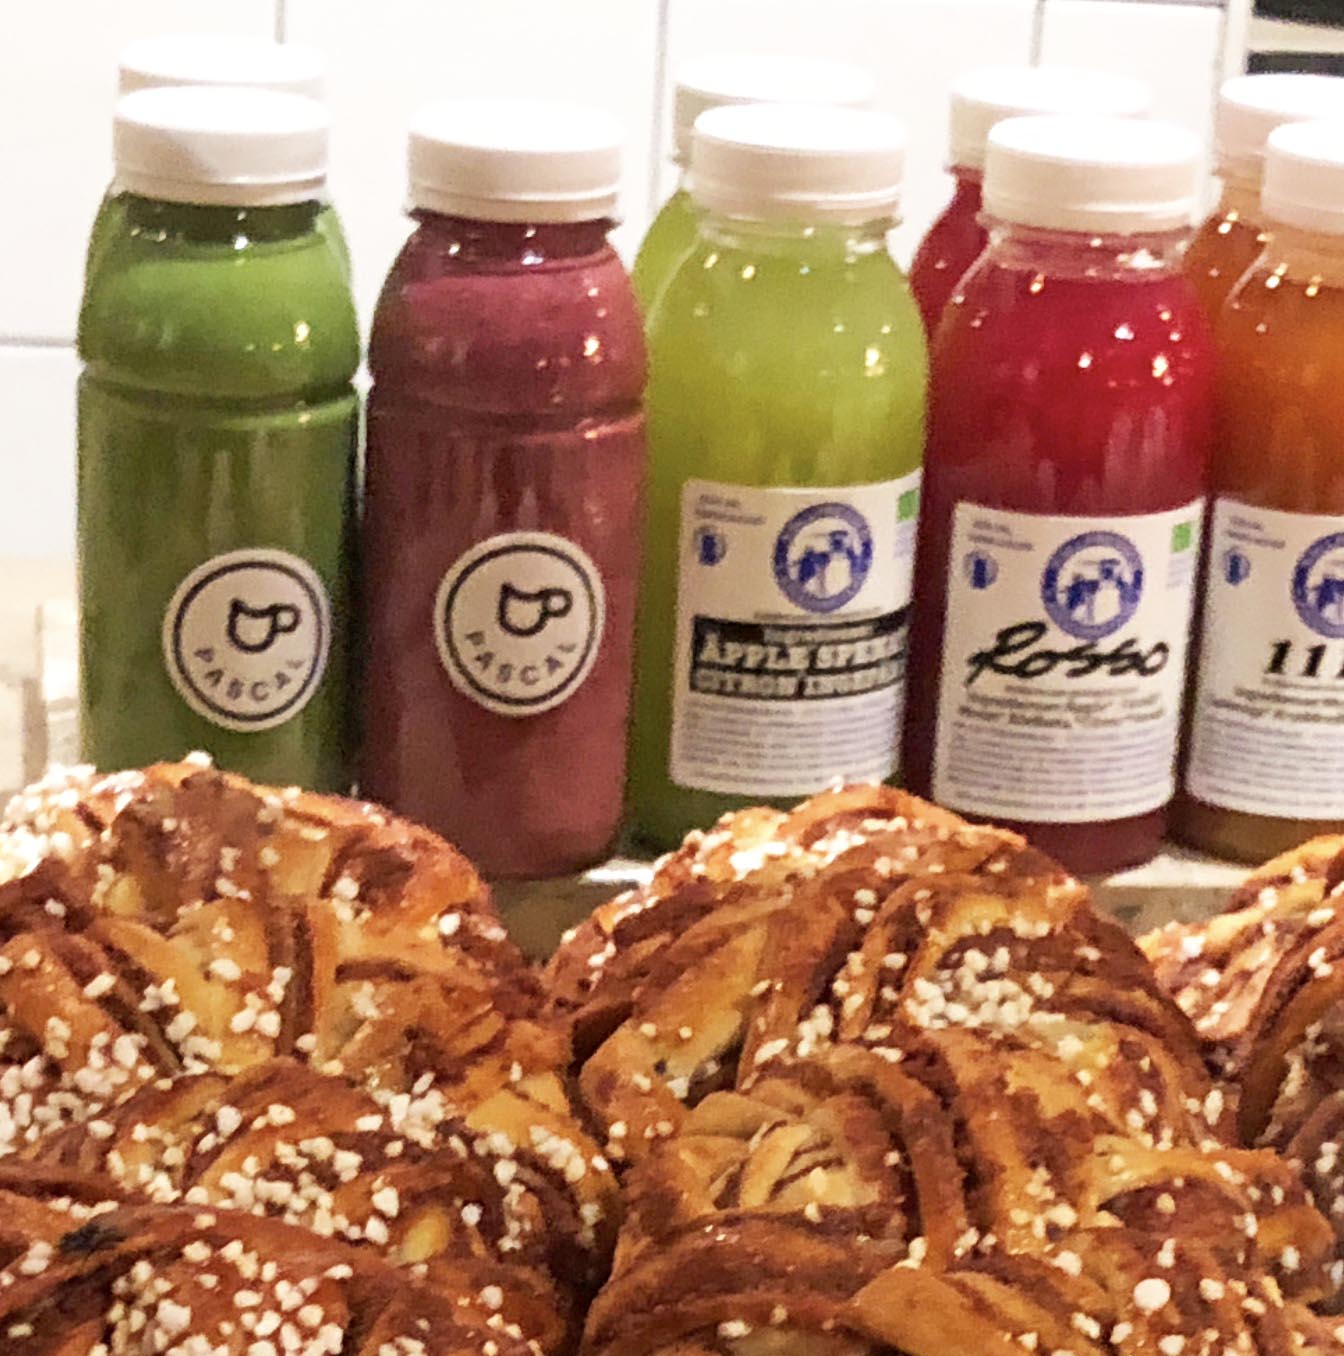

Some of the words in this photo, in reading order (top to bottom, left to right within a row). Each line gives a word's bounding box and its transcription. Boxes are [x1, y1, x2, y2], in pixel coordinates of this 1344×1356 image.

[193, 647, 304, 702] PASCAL
[465, 631, 577, 687] PASCAL
[964, 621, 1170, 688] Rosso
